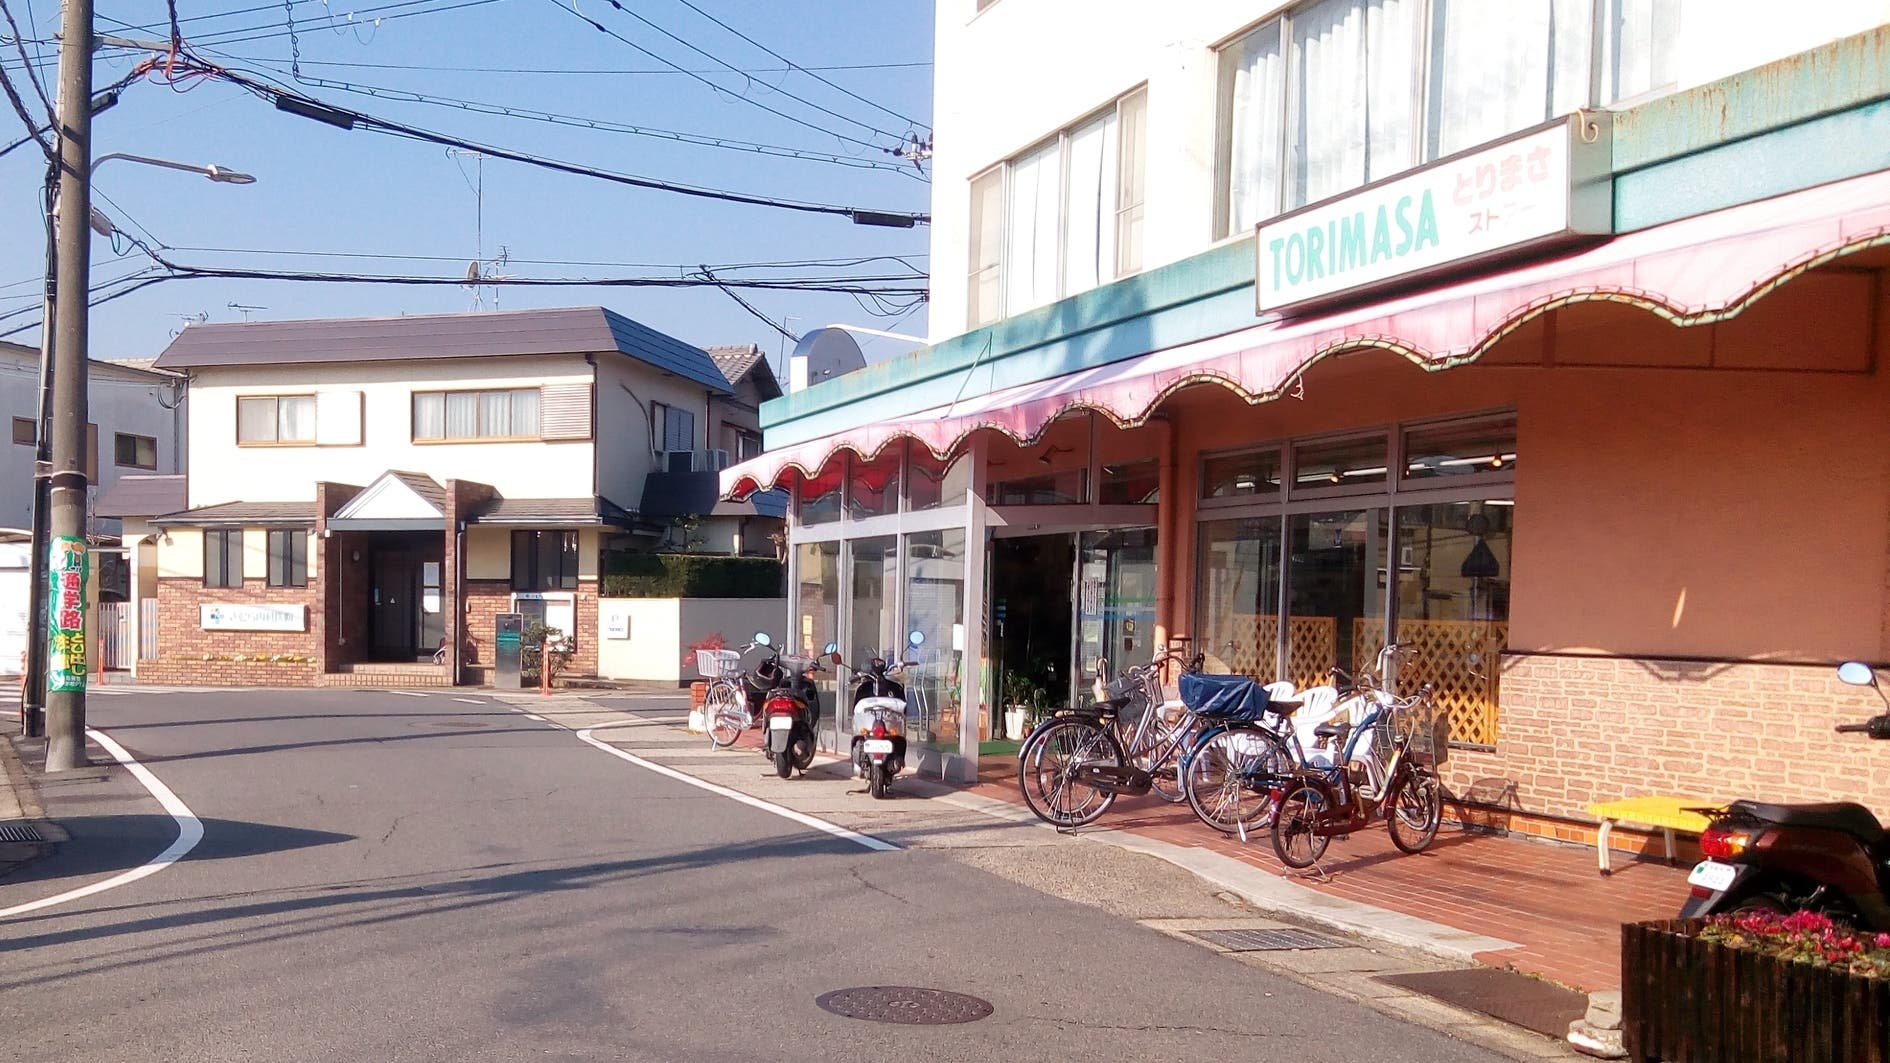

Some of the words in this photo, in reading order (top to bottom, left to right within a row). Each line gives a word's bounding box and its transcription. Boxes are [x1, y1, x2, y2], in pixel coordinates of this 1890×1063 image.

[1453, 146, 1552, 206] とりまさ
[1270, 189, 1439, 291] TORIMASA
[61, 572, 82, 630] 通学路
[70, 632, 86, 676] とび出し
